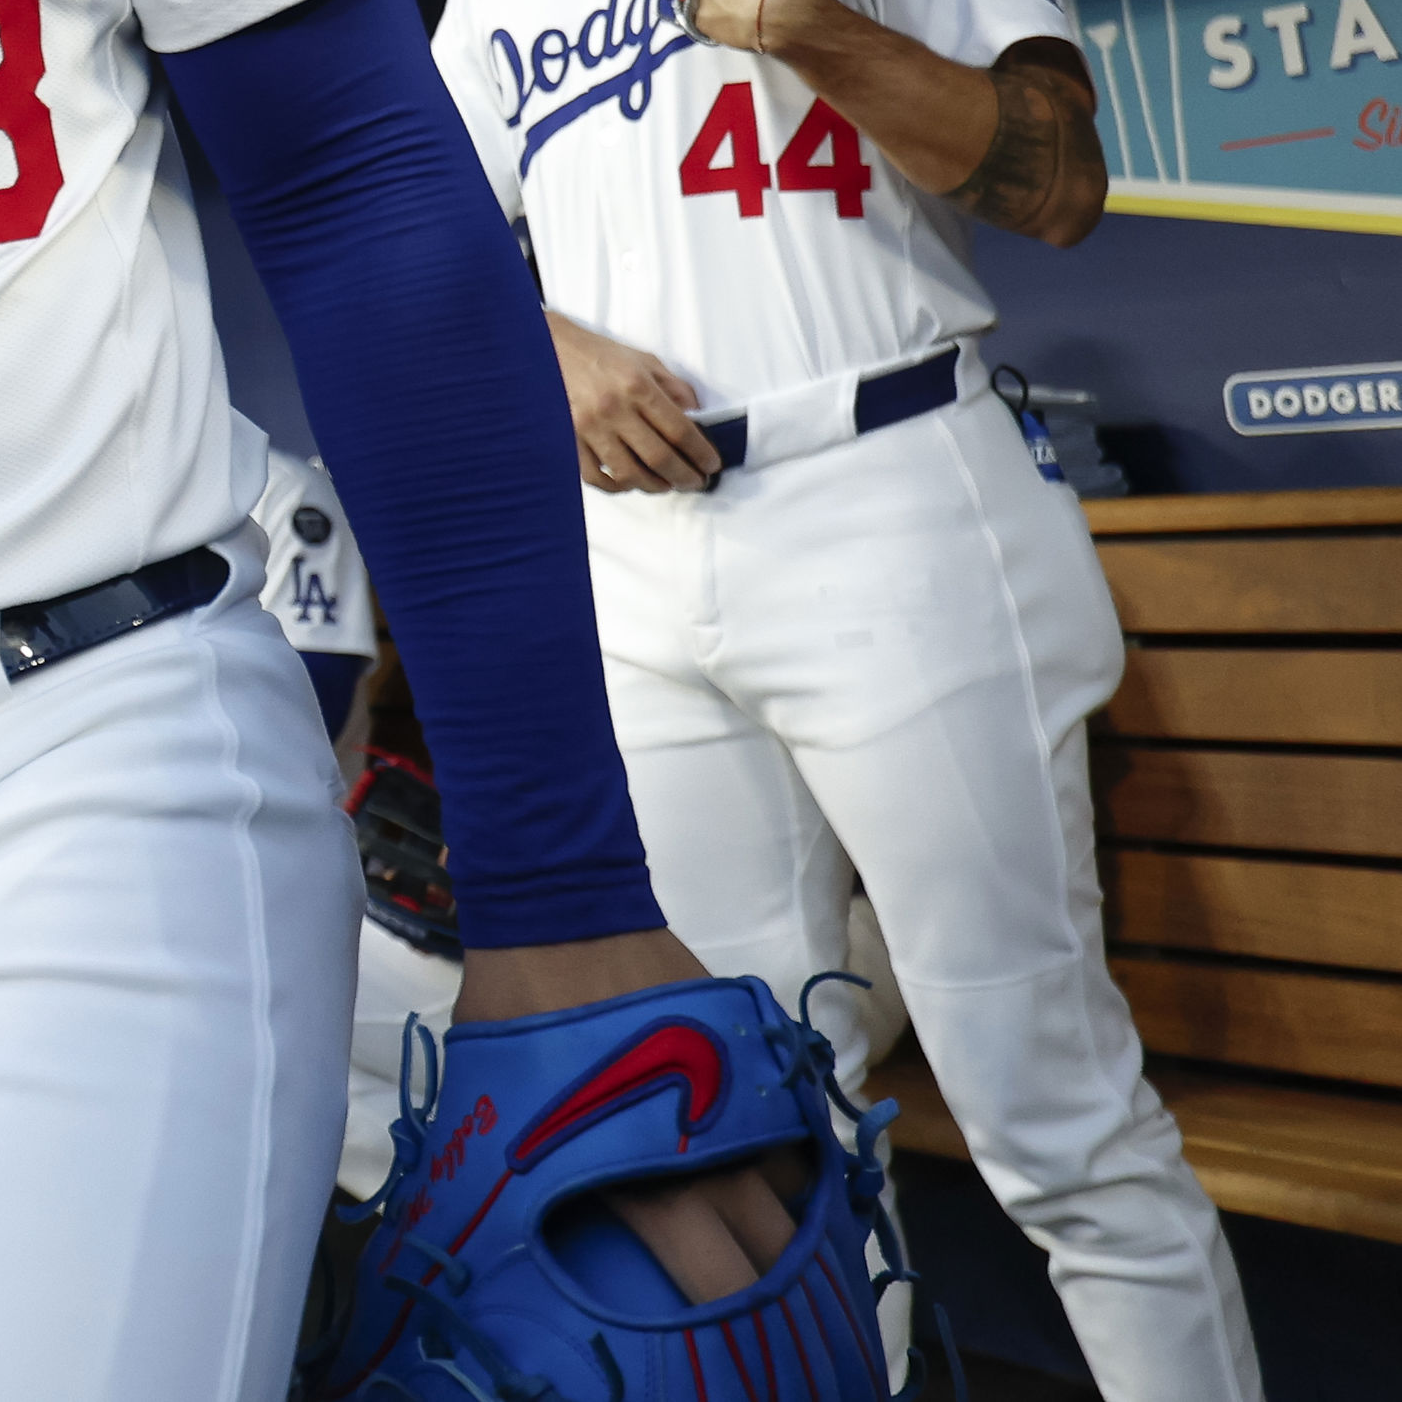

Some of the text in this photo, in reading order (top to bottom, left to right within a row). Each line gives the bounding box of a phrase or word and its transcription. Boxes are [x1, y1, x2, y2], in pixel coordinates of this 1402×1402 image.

[680, 82, 871, 219] 44
[1247, 379, 1402, 420] DODGER
[292, 554, 338, 624] LA
